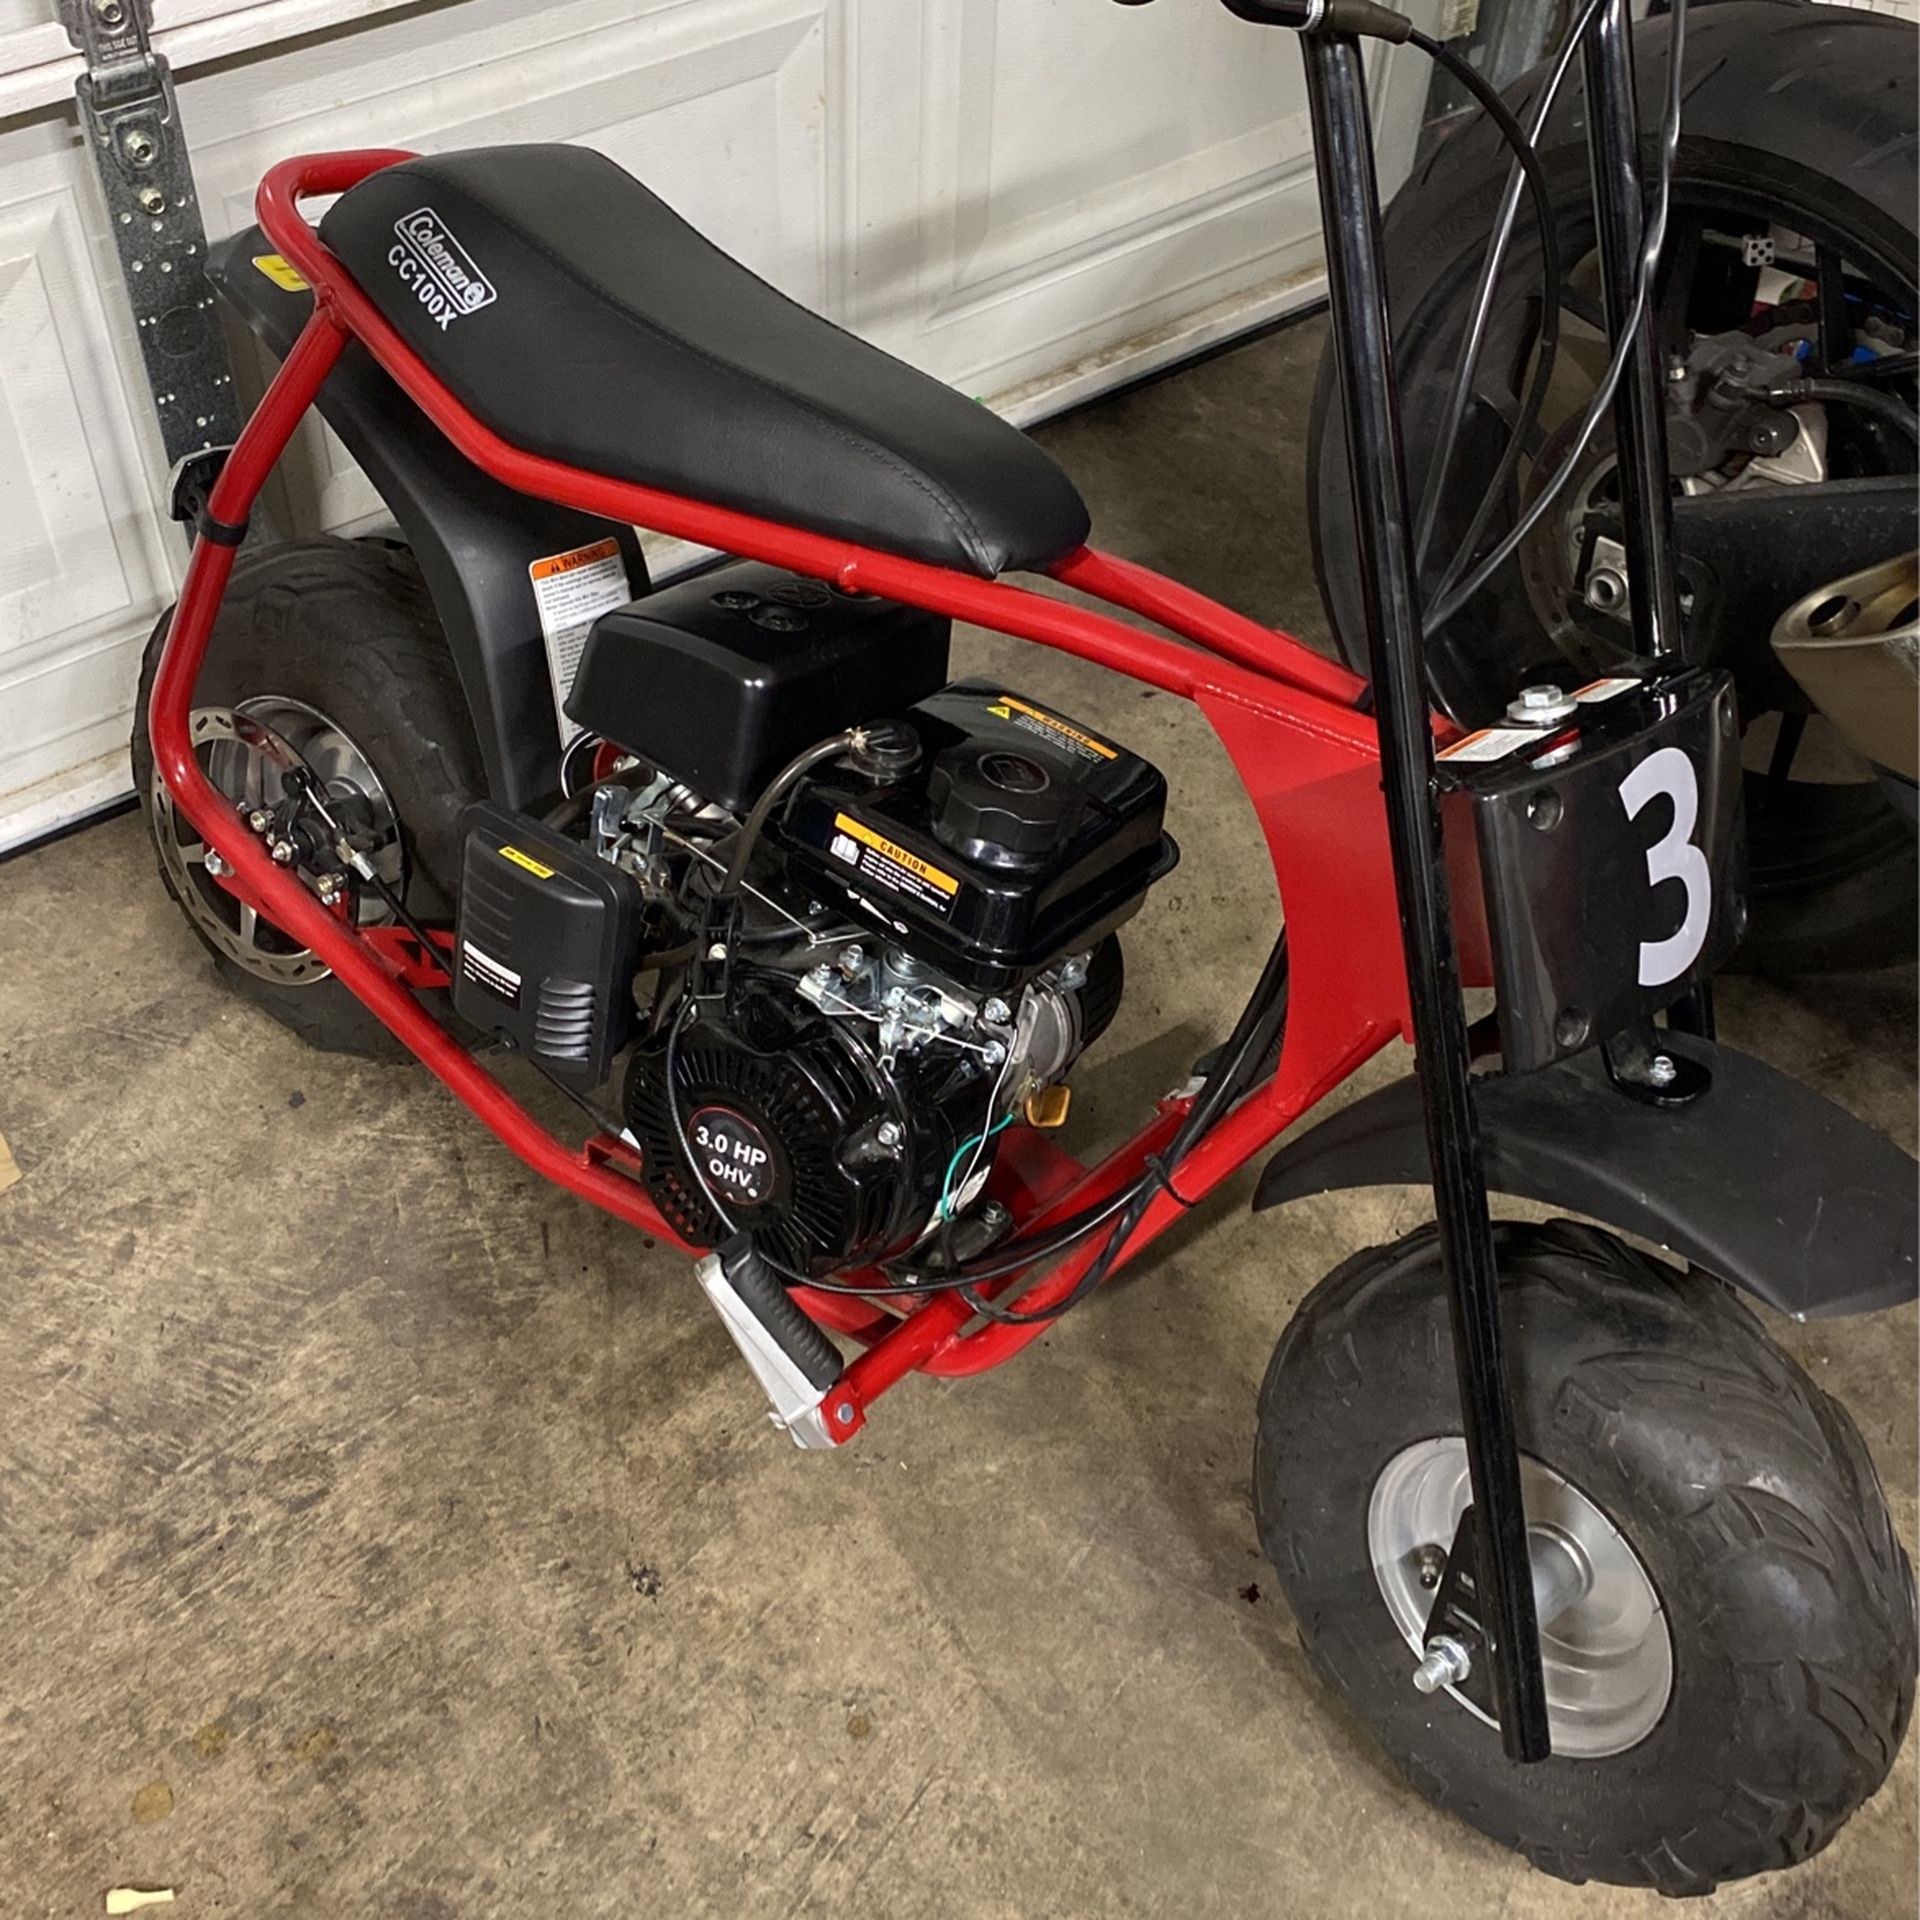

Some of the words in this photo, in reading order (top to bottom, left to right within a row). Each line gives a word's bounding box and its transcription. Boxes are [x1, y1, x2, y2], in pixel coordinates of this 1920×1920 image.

[409, 216, 470, 291] Coleman
[388, 245, 458, 331] CC100X
[563, 547, 605, 568] WARNING
[1042, 716, 1091, 744] WARNING
[879, 841, 927, 874] CAUTION
[1618, 747, 1712, 986] 3
[695, 1125, 728, 1153] 3.0
[733, 1141, 767, 1167] HP
[709, 1158, 753, 1187] OHV
